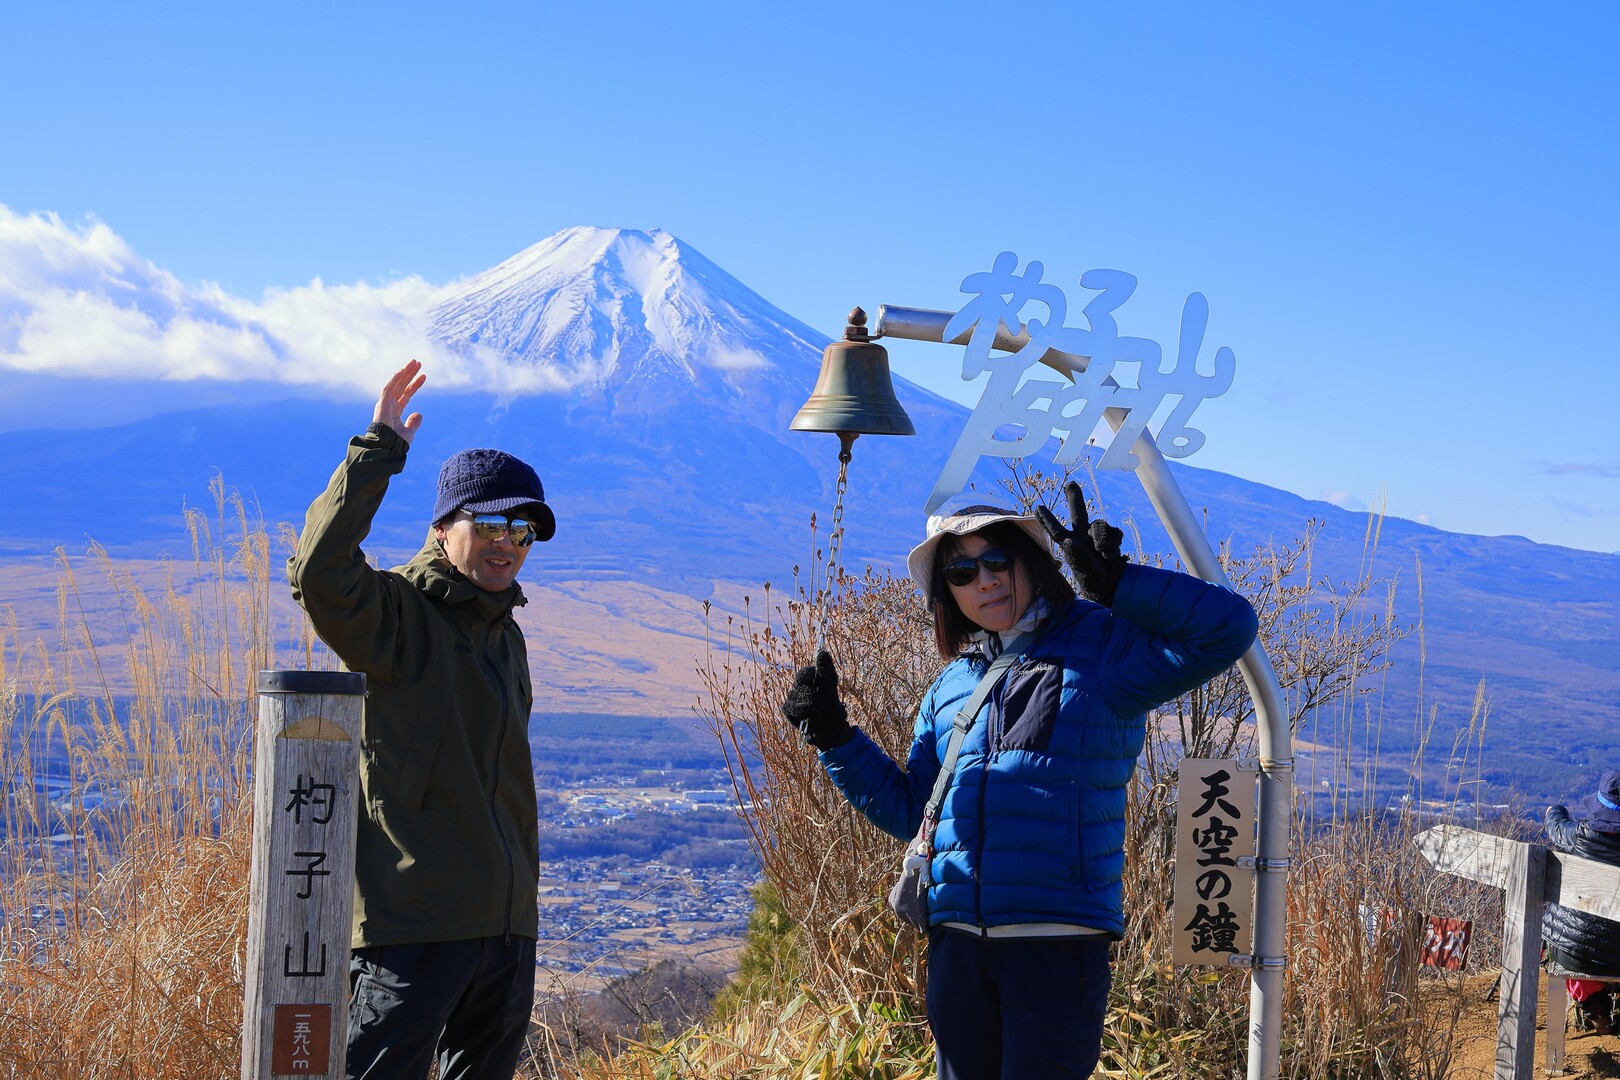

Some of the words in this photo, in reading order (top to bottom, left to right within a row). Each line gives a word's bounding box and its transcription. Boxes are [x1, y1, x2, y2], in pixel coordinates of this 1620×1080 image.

[284, 774, 336, 978] 杓子山
[1184, 769, 1241, 954] 天空の鐘
[292, 1013, 312, 1069] 一五九八m
